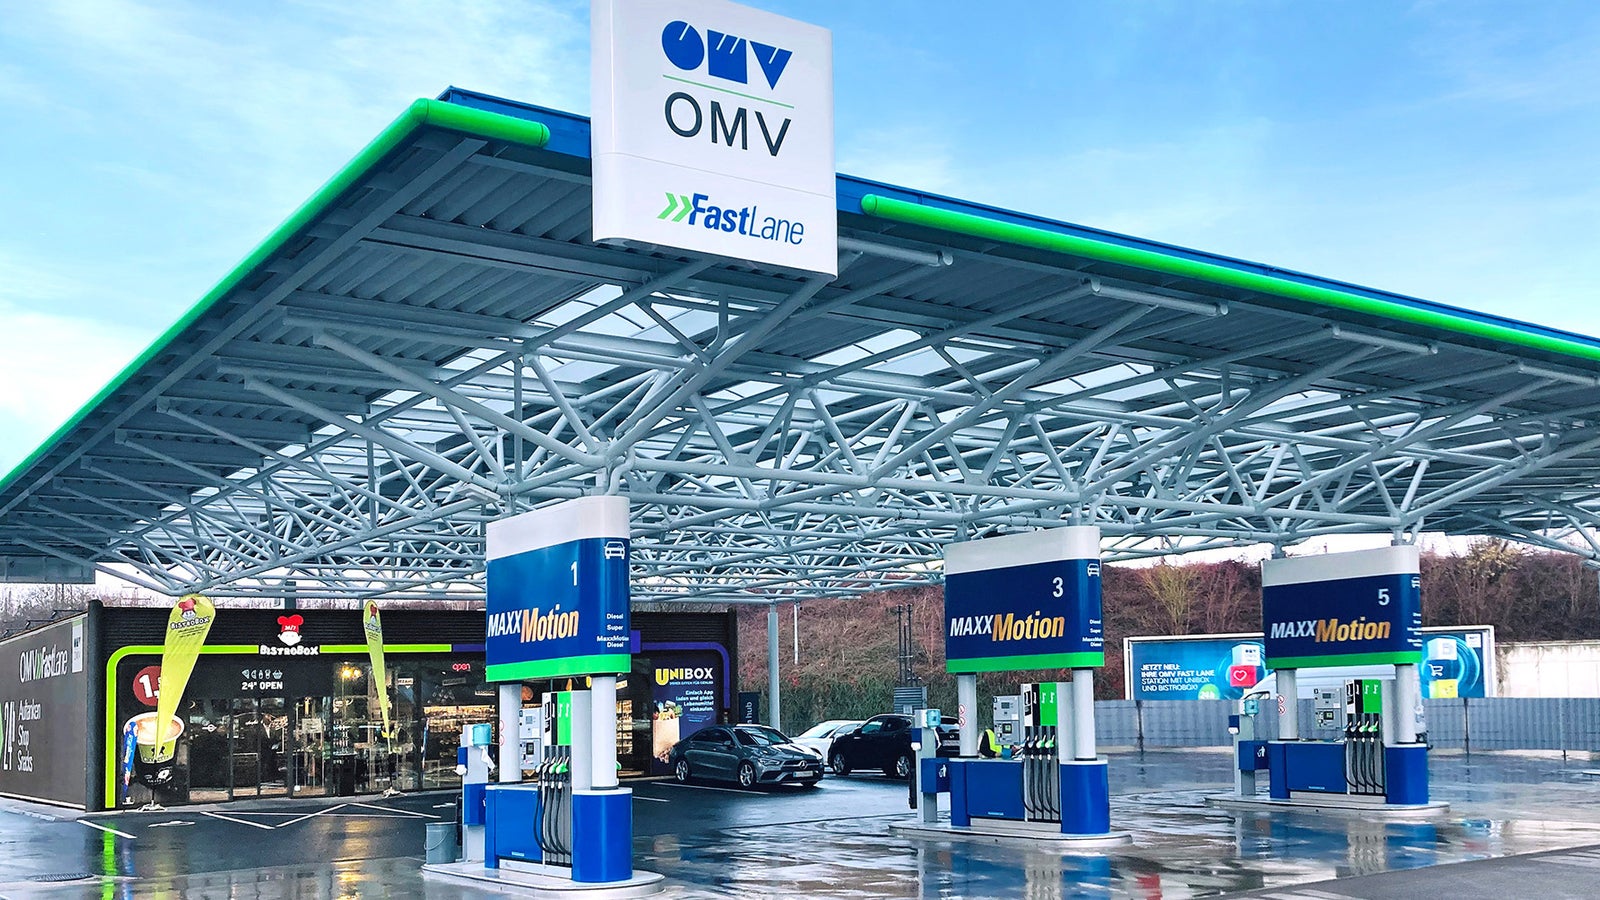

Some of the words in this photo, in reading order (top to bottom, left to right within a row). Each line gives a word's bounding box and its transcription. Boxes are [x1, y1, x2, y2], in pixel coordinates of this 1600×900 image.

[664, 91, 791, 157] OMV
[688, 193, 804, 245] FastLane
[570, 561, 578, 586] 1
[1052, 576, 1064, 598] 3
[1378, 588, 1390, 606] 5
[487, 603, 579, 643] MAXXMotion
[950, 610, 1065, 642] MAXXMotion
[1270, 616, 1391, 643] MAXXMotion
[19, 650, 37, 683] OMV
[41, 644, 68, 679] FastLane
[655, 668, 713, 685] UNIBOX
[259, 681, 283, 690] OPEN
